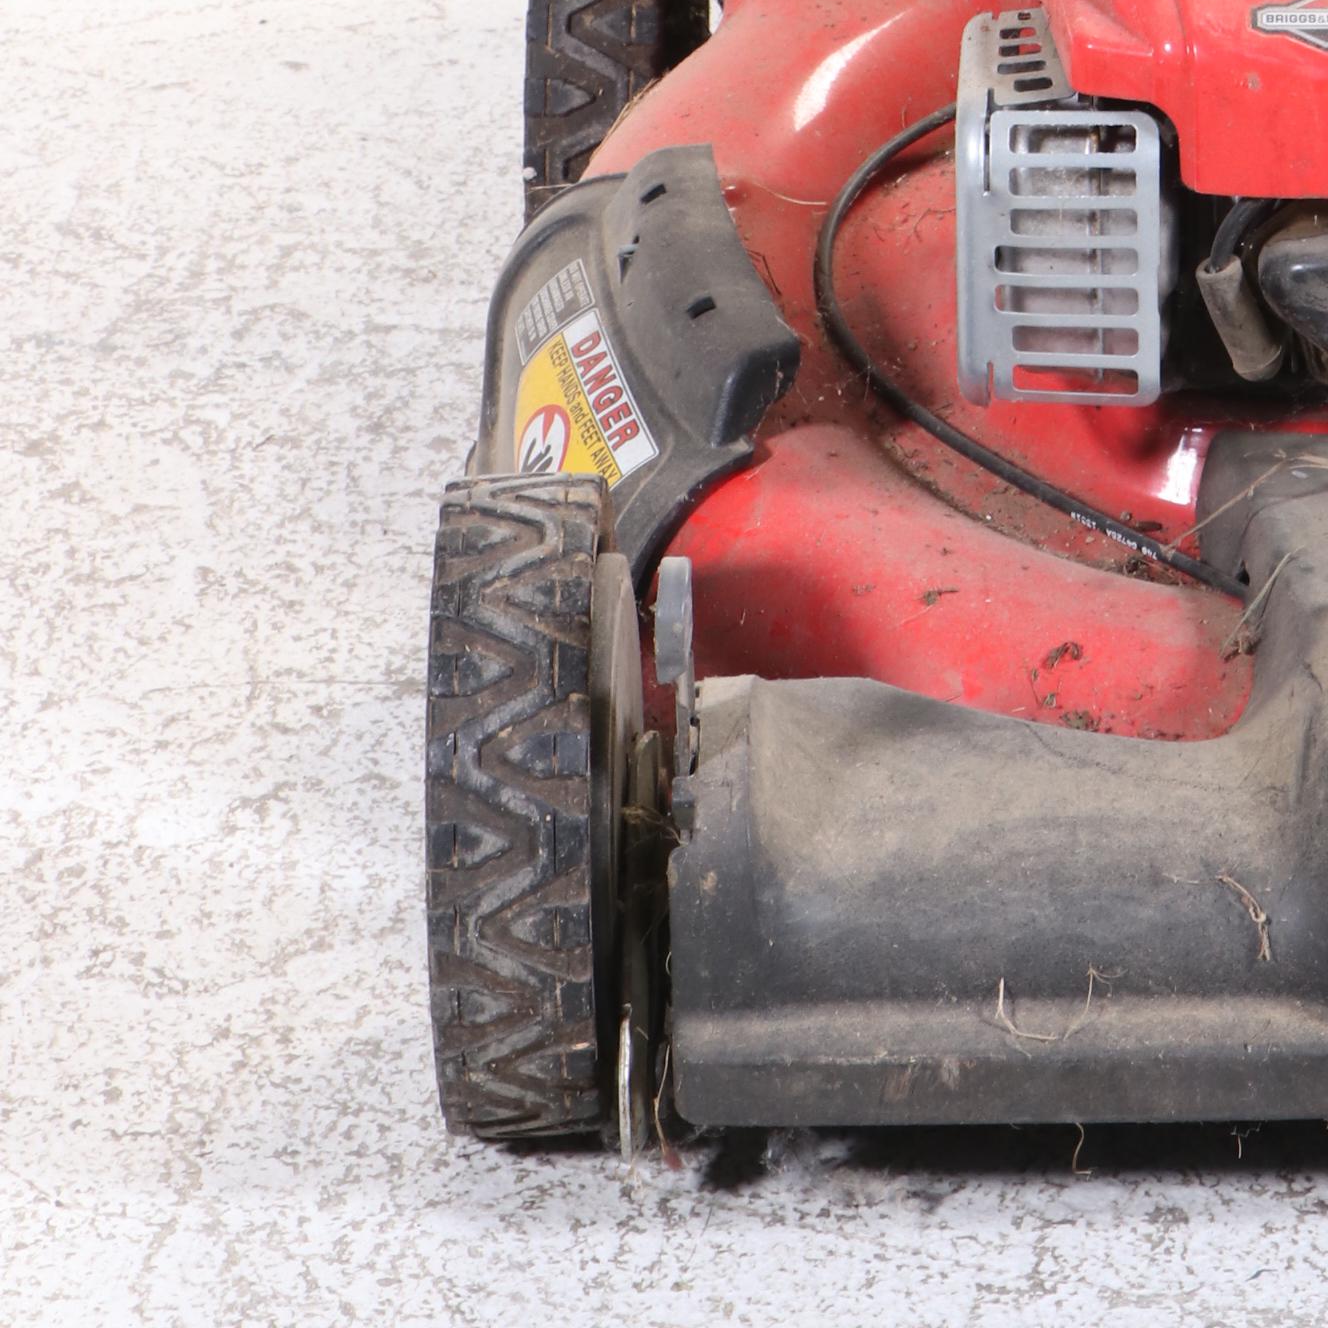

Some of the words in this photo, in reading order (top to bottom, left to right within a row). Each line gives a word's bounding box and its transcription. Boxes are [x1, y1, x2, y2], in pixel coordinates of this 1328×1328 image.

[547, 339, 570, 368] KEEP
[556, 362, 579, 404] HANDS
[571, 330, 641, 452] DANGER
[570, 400, 589, 425] and
[579, 419, 600, 450] FEET
[590, 442, 618, 480] AWAY
